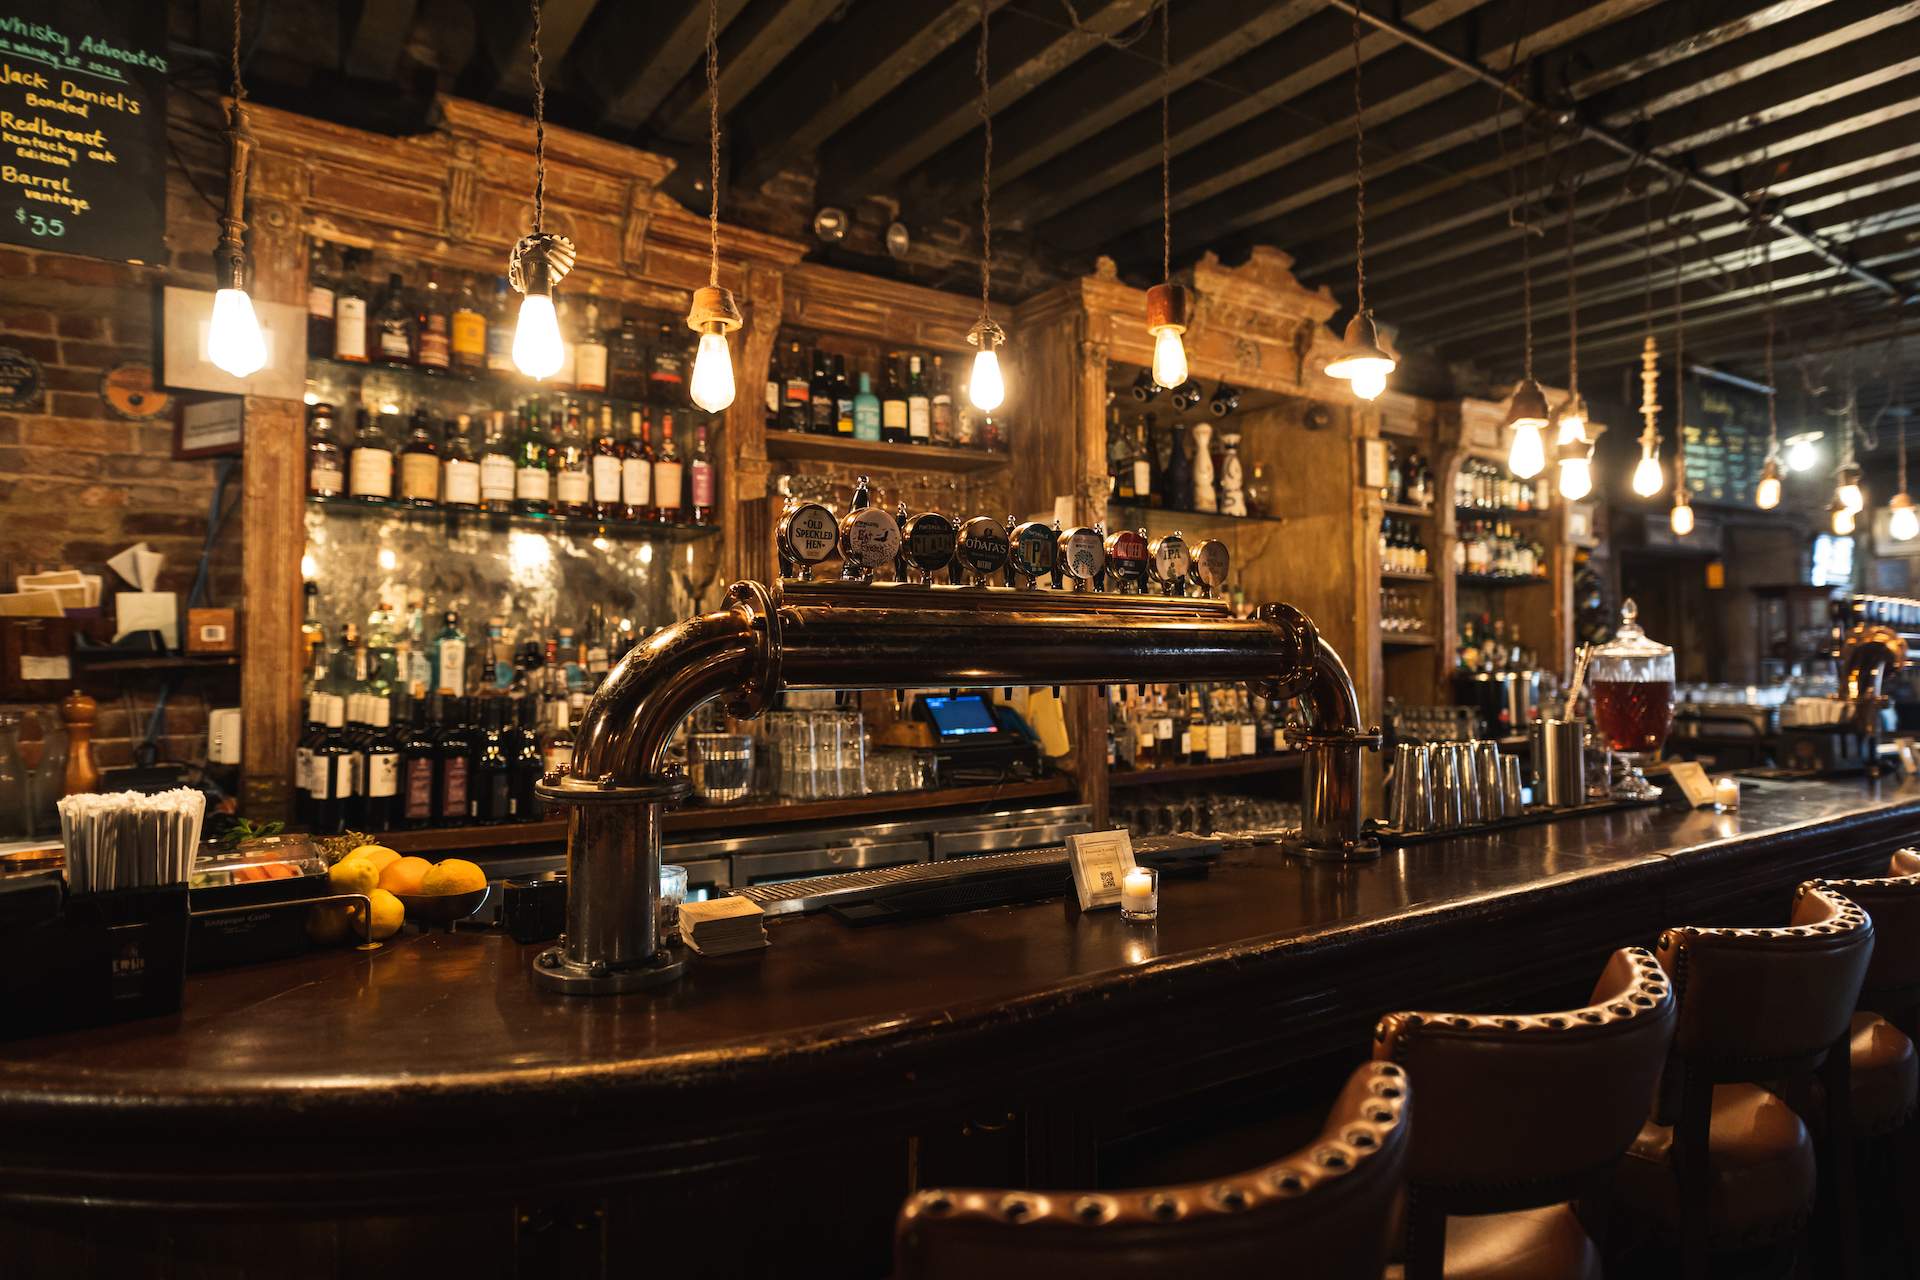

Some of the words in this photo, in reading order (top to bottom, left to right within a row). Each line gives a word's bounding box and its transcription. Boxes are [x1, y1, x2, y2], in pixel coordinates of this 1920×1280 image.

[88, 61, 121, 78] 2022
[0, 64, 48, 90] Jack
[61, 80, 141, 115] Daniel's
[25, 92, 88, 119] Bonded
[0, 111, 108, 148] Redbreast
[2, 165, 73, 193] Barrel
[807, 519, 823, 530] OLD
[795, 527, 833, 540] SPECKLED
[806, 540, 822, 549] HEN
[1163, 549, 1181, 561] IPA
